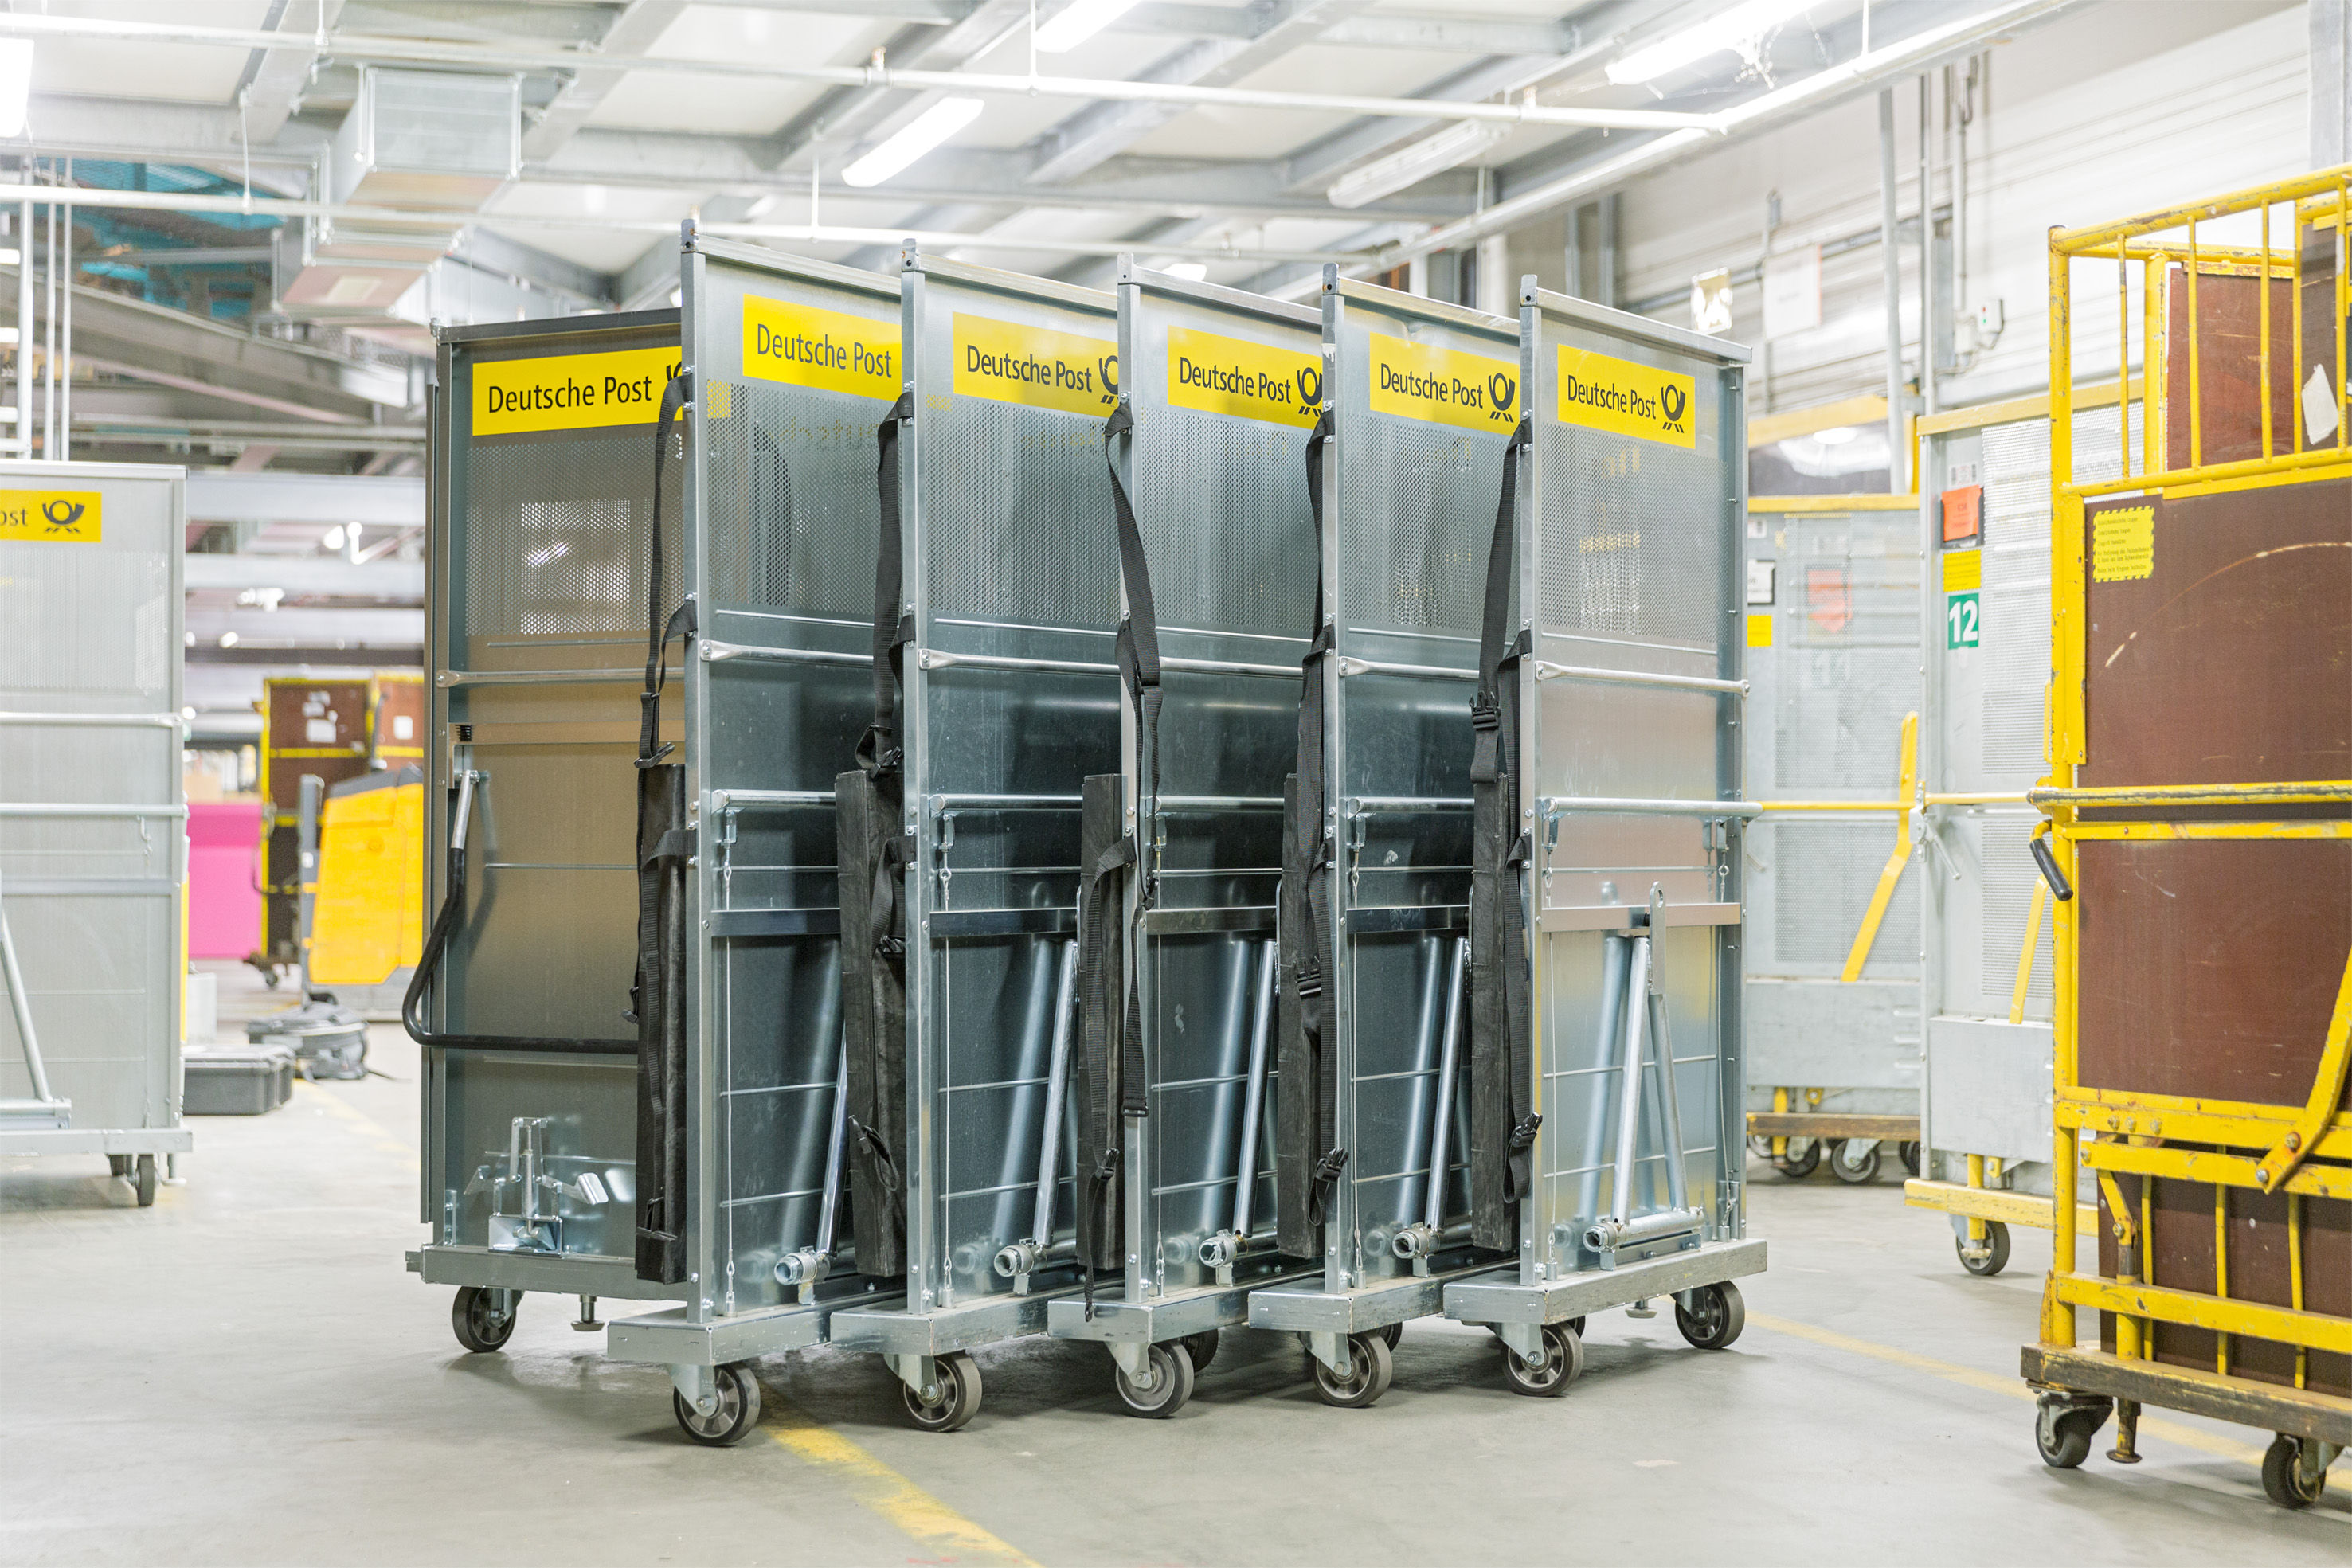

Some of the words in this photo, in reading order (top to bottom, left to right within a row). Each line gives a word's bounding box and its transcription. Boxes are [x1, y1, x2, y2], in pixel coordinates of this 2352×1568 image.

[756, 323, 847, 371] Deutsche
[852, 342, 893, 379] Post
[966, 344, 1051, 386] Deutsche
[1055, 360, 1093, 393] Post
[487, 379, 595, 414] Deutsche
[603, 374, 652, 405] Post
[1179, 356, 1254, 397] Deutsche
[1258, 372, 1292, 405] Post
[1380, 362, 1449, 403] Deutsche
[1452, 377, 1484, 409] Post
[1567, 374, 1627, 413] Deutsche
[1630, 389, 1657, 420] Post
[1948, 600, 1979, 643] 12
